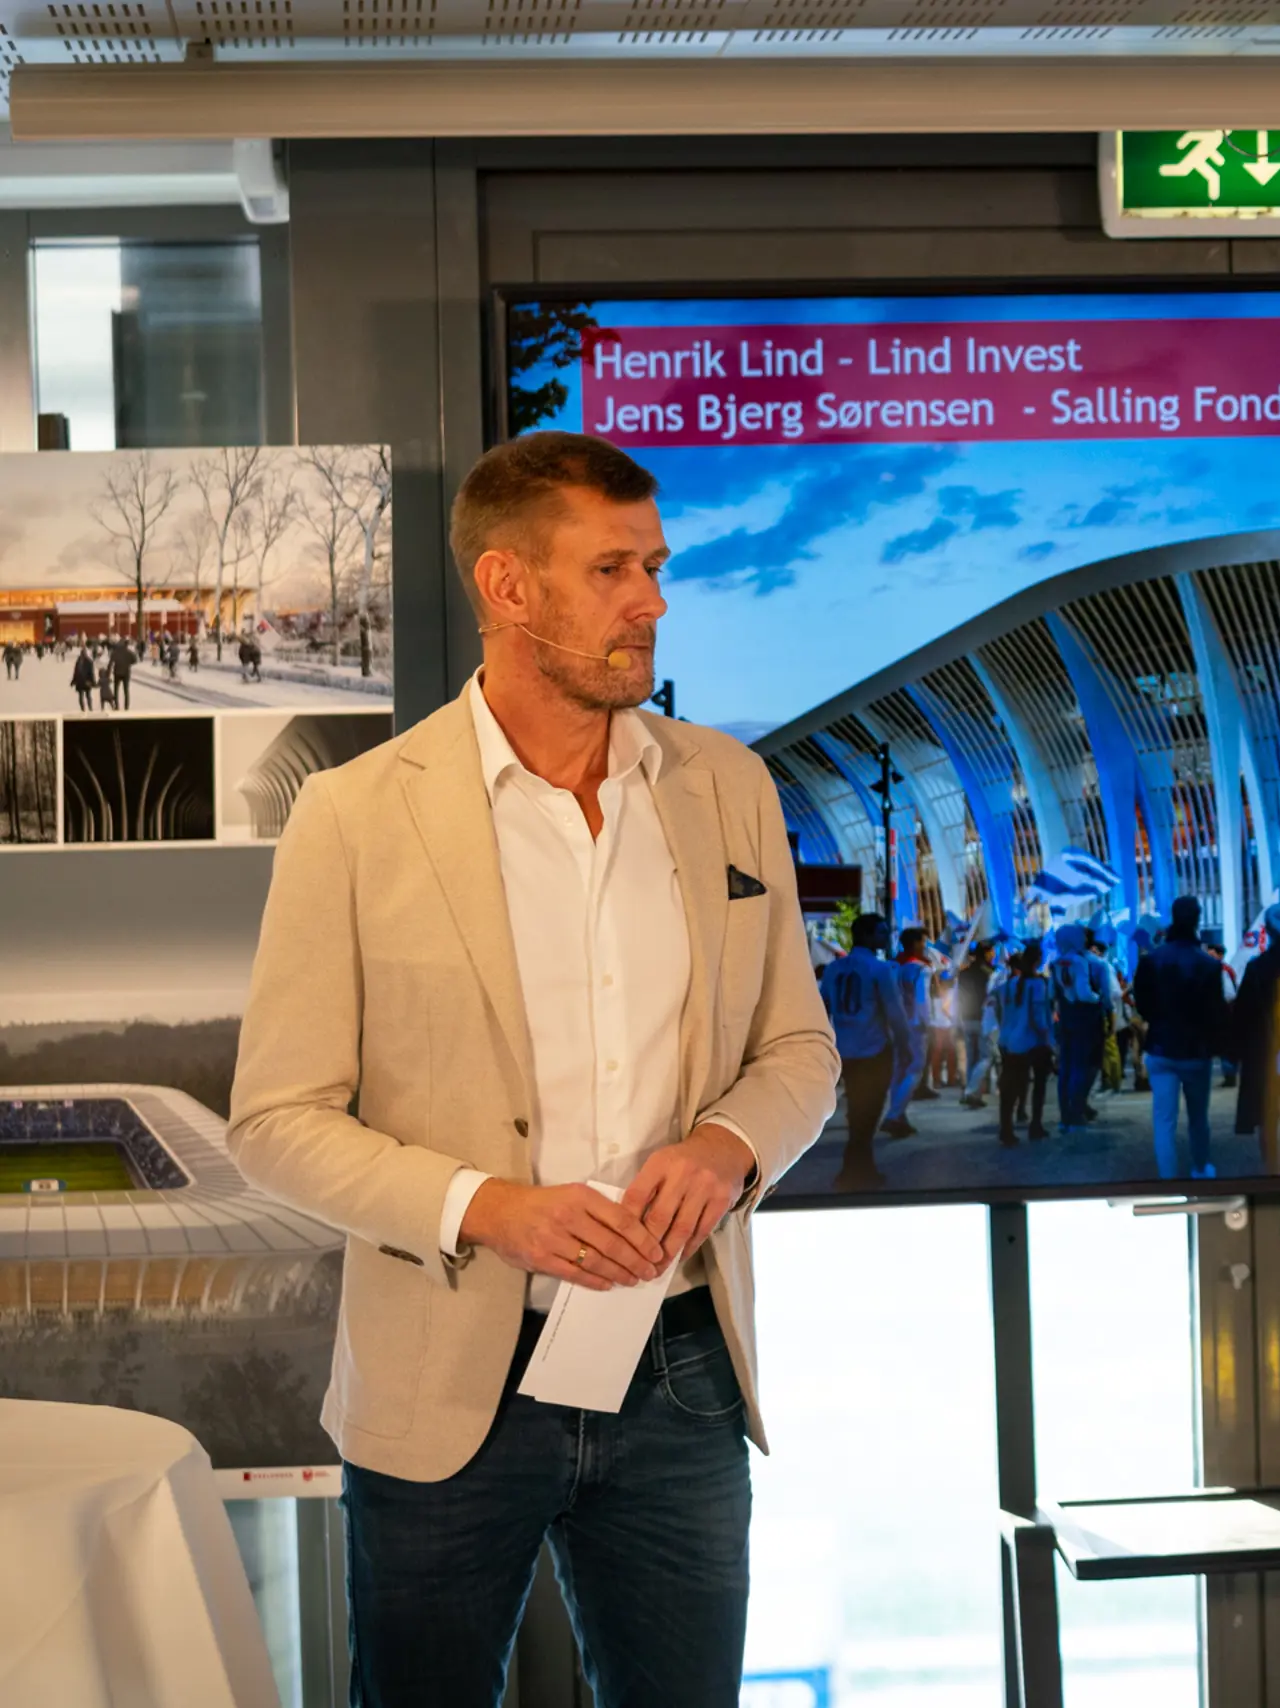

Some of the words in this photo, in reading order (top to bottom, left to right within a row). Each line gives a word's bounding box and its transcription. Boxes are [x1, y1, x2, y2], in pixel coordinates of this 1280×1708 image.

[594, 341, 726, 379] Henrik
[742, 338, 824, 377] Lind
[869, 336, 951, 375] Lind
[967, 337, 1083, 374] Invest
[595, 396, 684, 432] Jens
[698, 393, 804, 440] Bjerg
[816, 392, 994, 429] Sørensen
[1051, 386, 1180, 431] Salling
